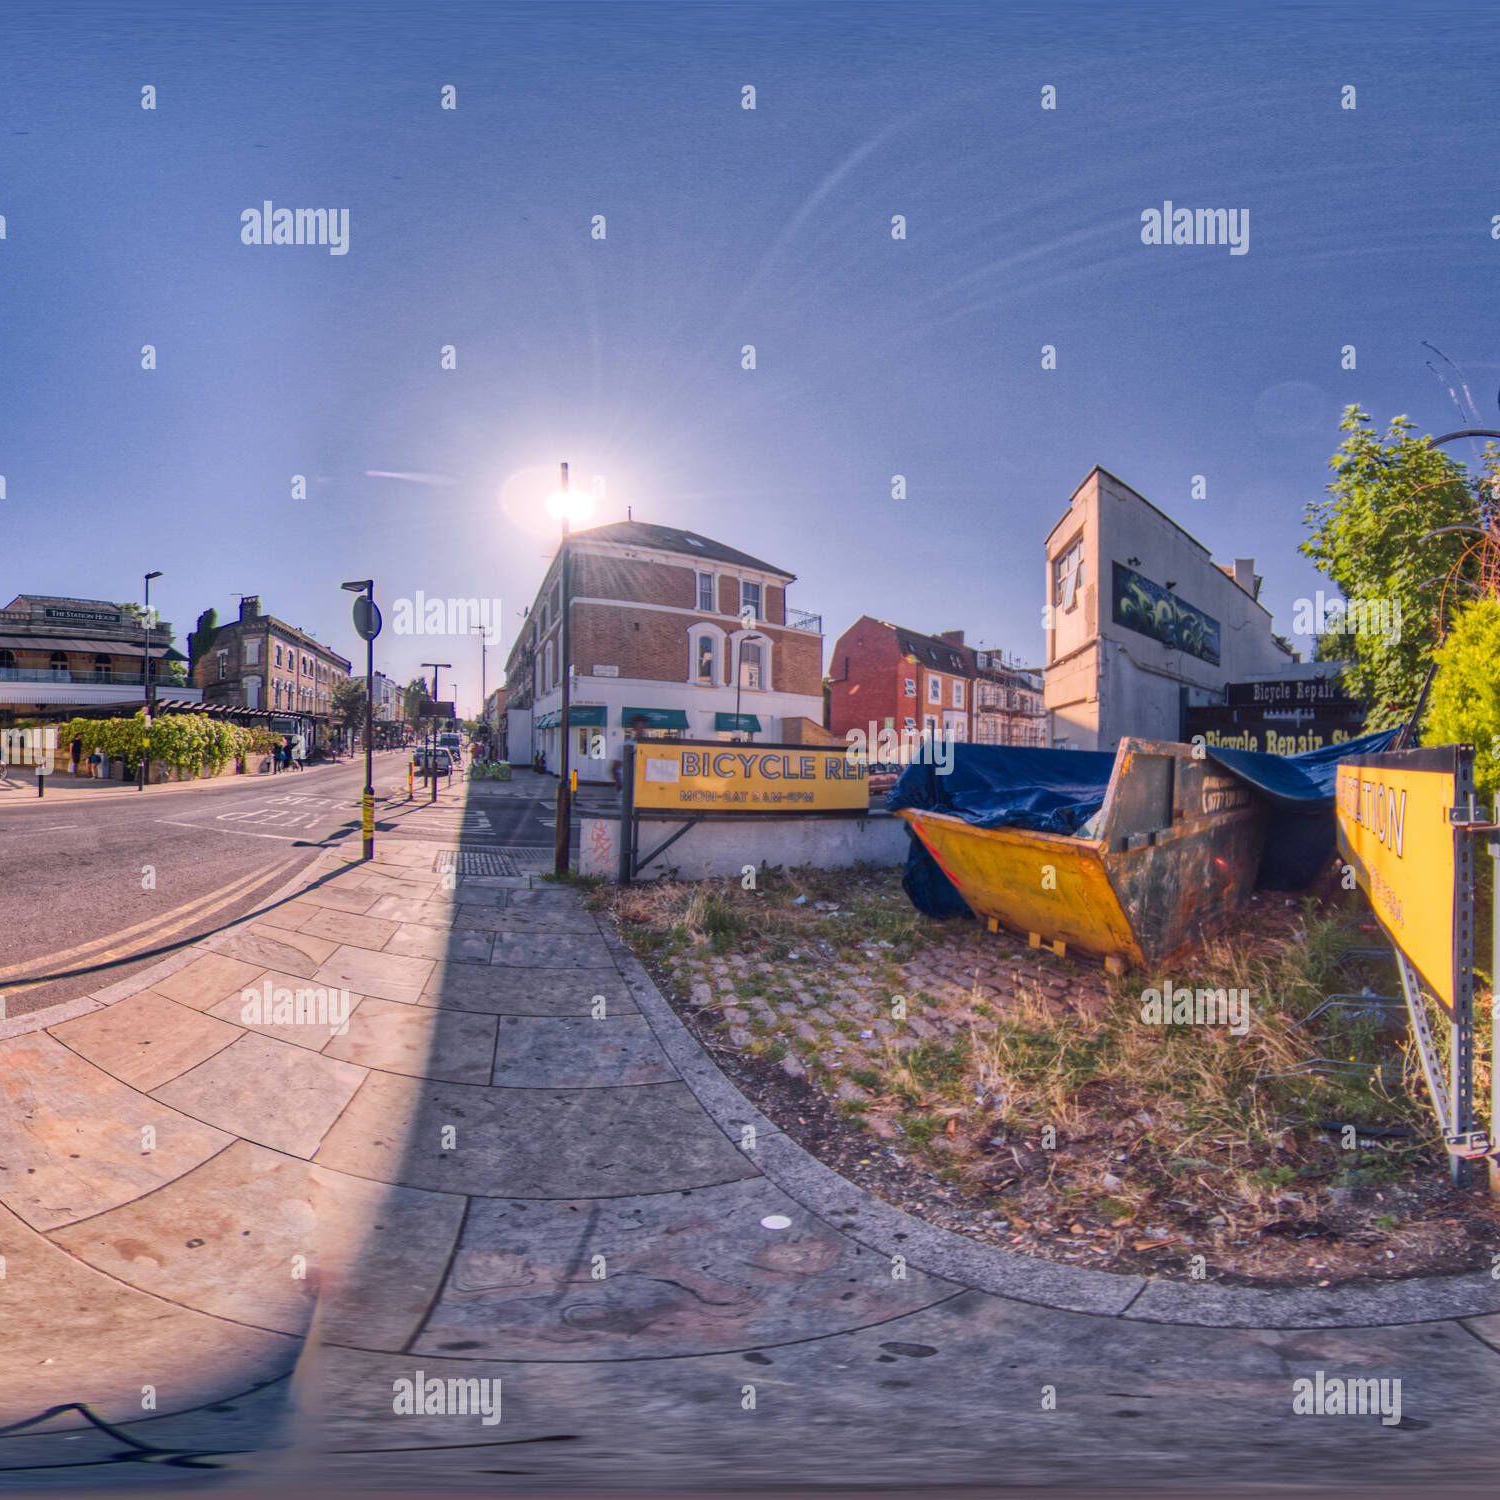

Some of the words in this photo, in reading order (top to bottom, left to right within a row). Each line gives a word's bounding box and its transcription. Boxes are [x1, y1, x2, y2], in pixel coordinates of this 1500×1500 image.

[1253, 681, 1290, 703] Bicycle
[1297, 680, 1335, 703] Repair
[681, 752, 816, 779] BICYCLE
